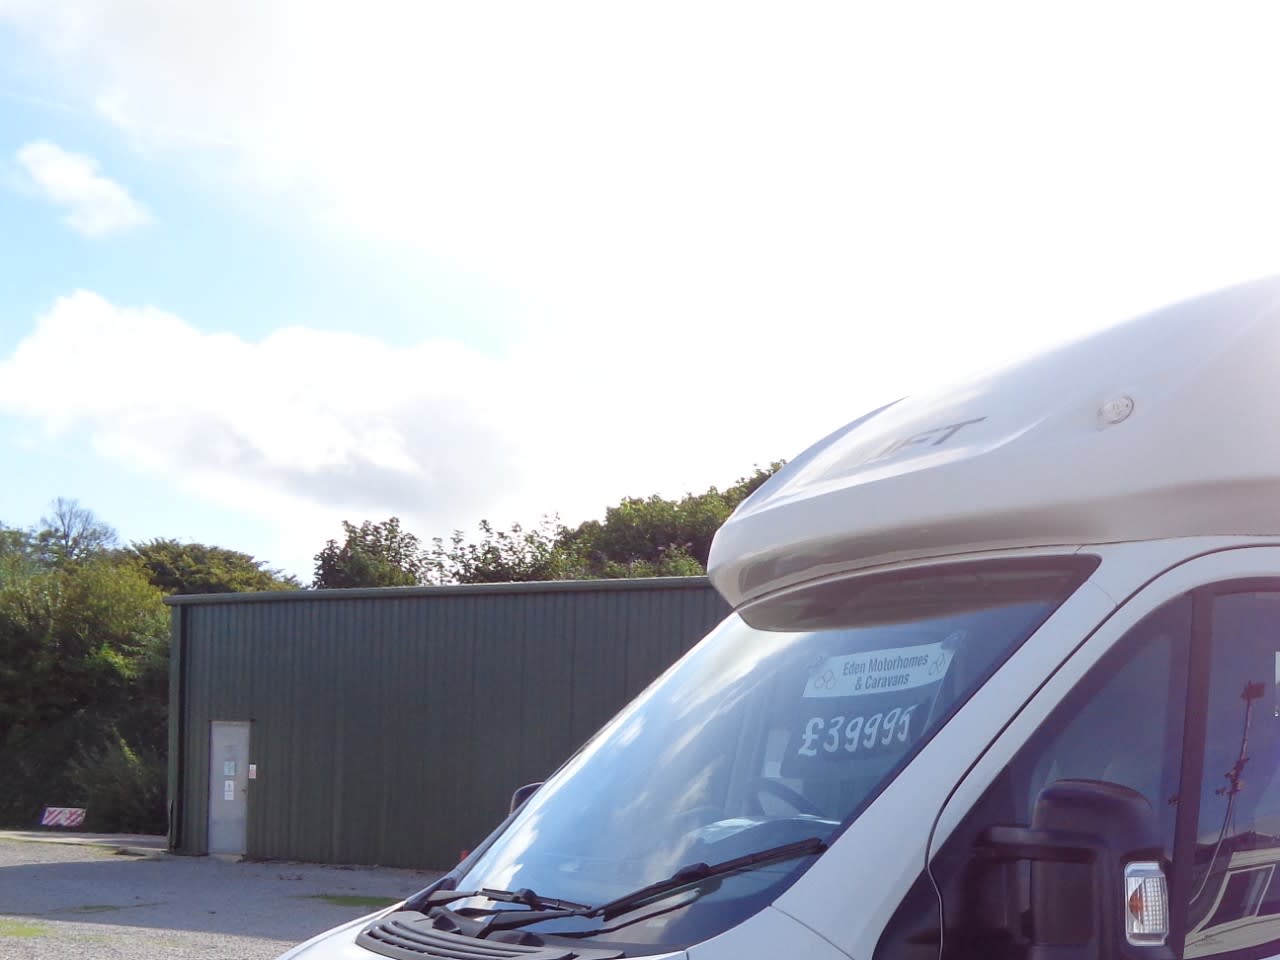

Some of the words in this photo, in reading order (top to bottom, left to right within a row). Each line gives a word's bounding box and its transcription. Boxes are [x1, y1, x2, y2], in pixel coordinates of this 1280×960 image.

[842, 661, 866, 676] Eden
[868, 654, 929, 674] Motorhomes
[854, 679, 863, 691] &
[864, 673, 911, 690] Caravans
